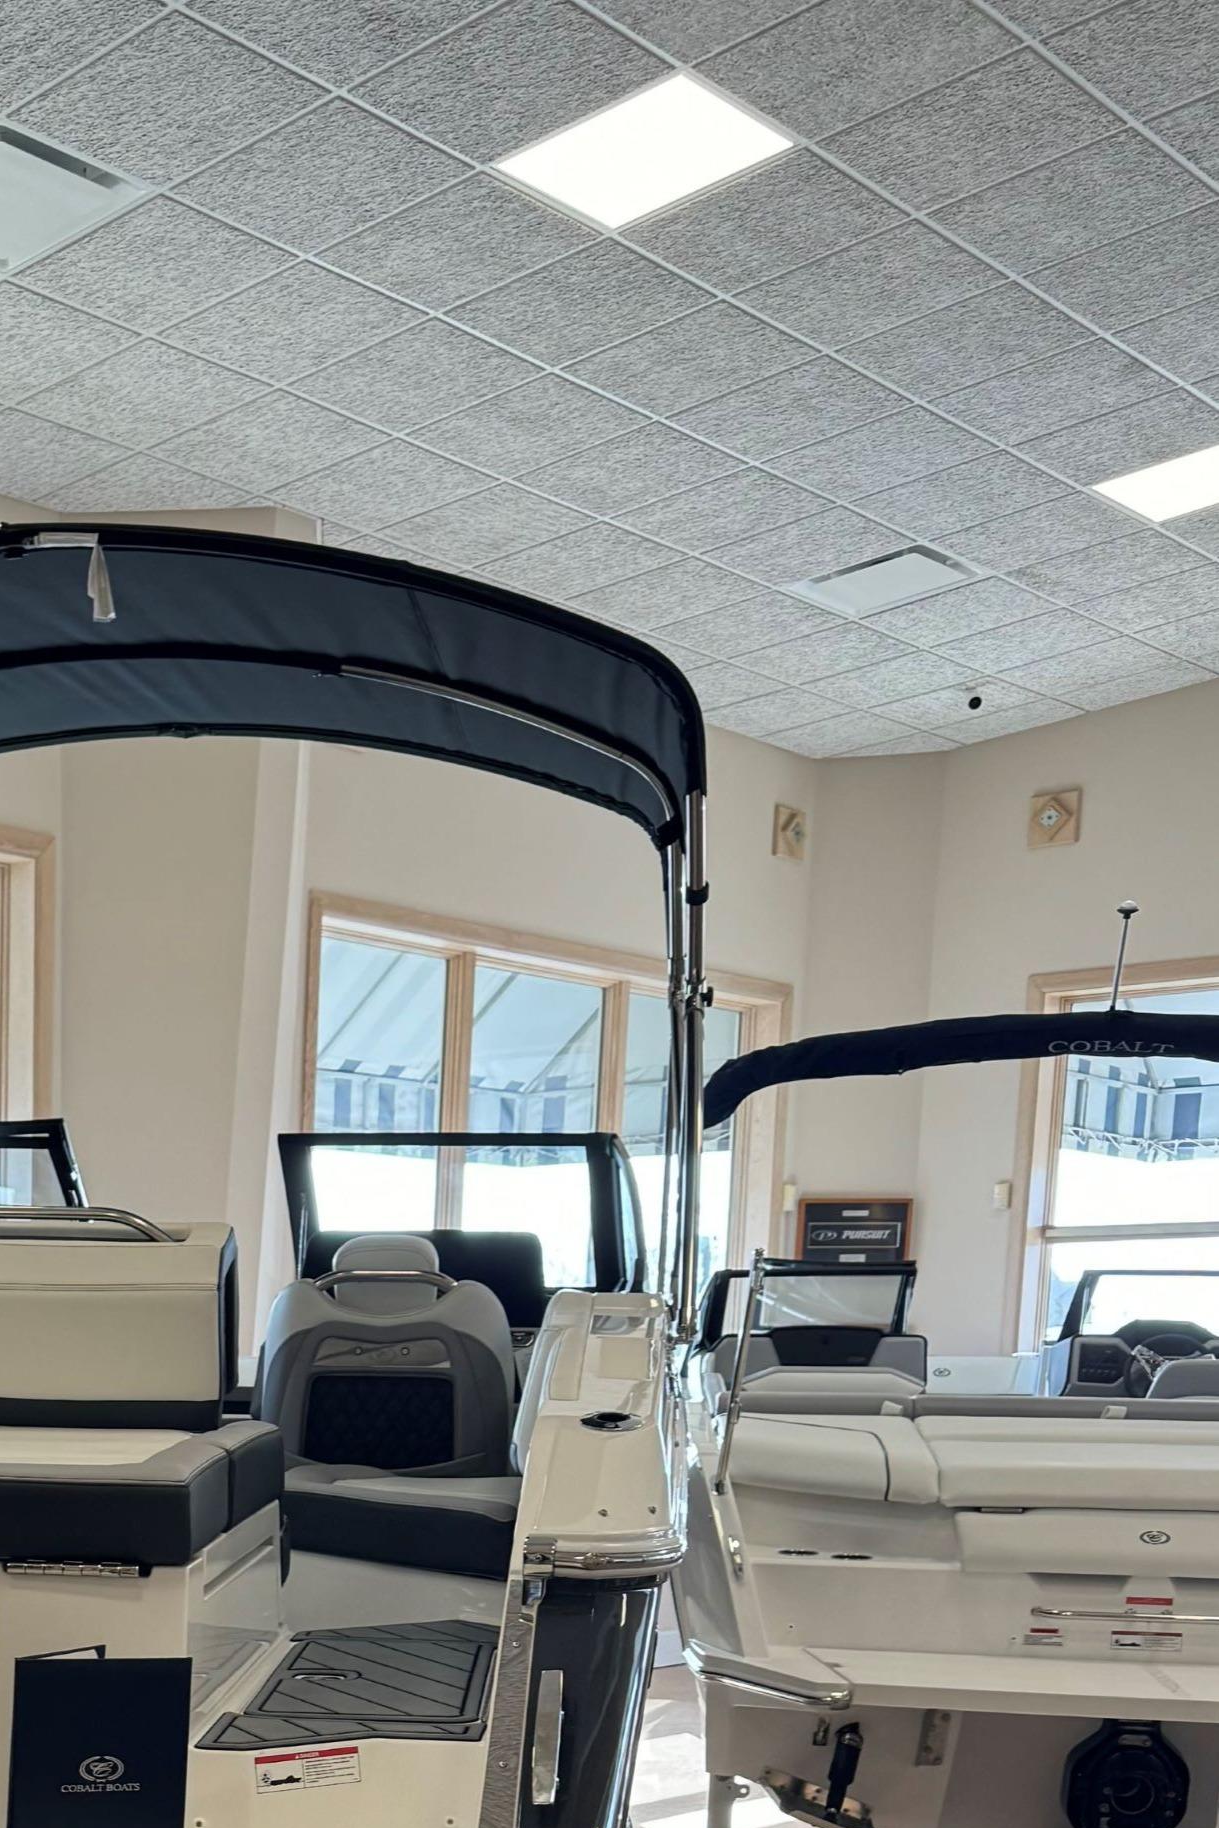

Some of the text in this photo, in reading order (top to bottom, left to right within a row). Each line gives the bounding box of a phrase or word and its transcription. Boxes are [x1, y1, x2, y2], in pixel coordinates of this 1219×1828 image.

[1047, 1040, 1175, 1053] COBALT
[842, 1230, 891, 1240] PURSUIT
[61, 1782, 141, 1793] COBALT BOATS
